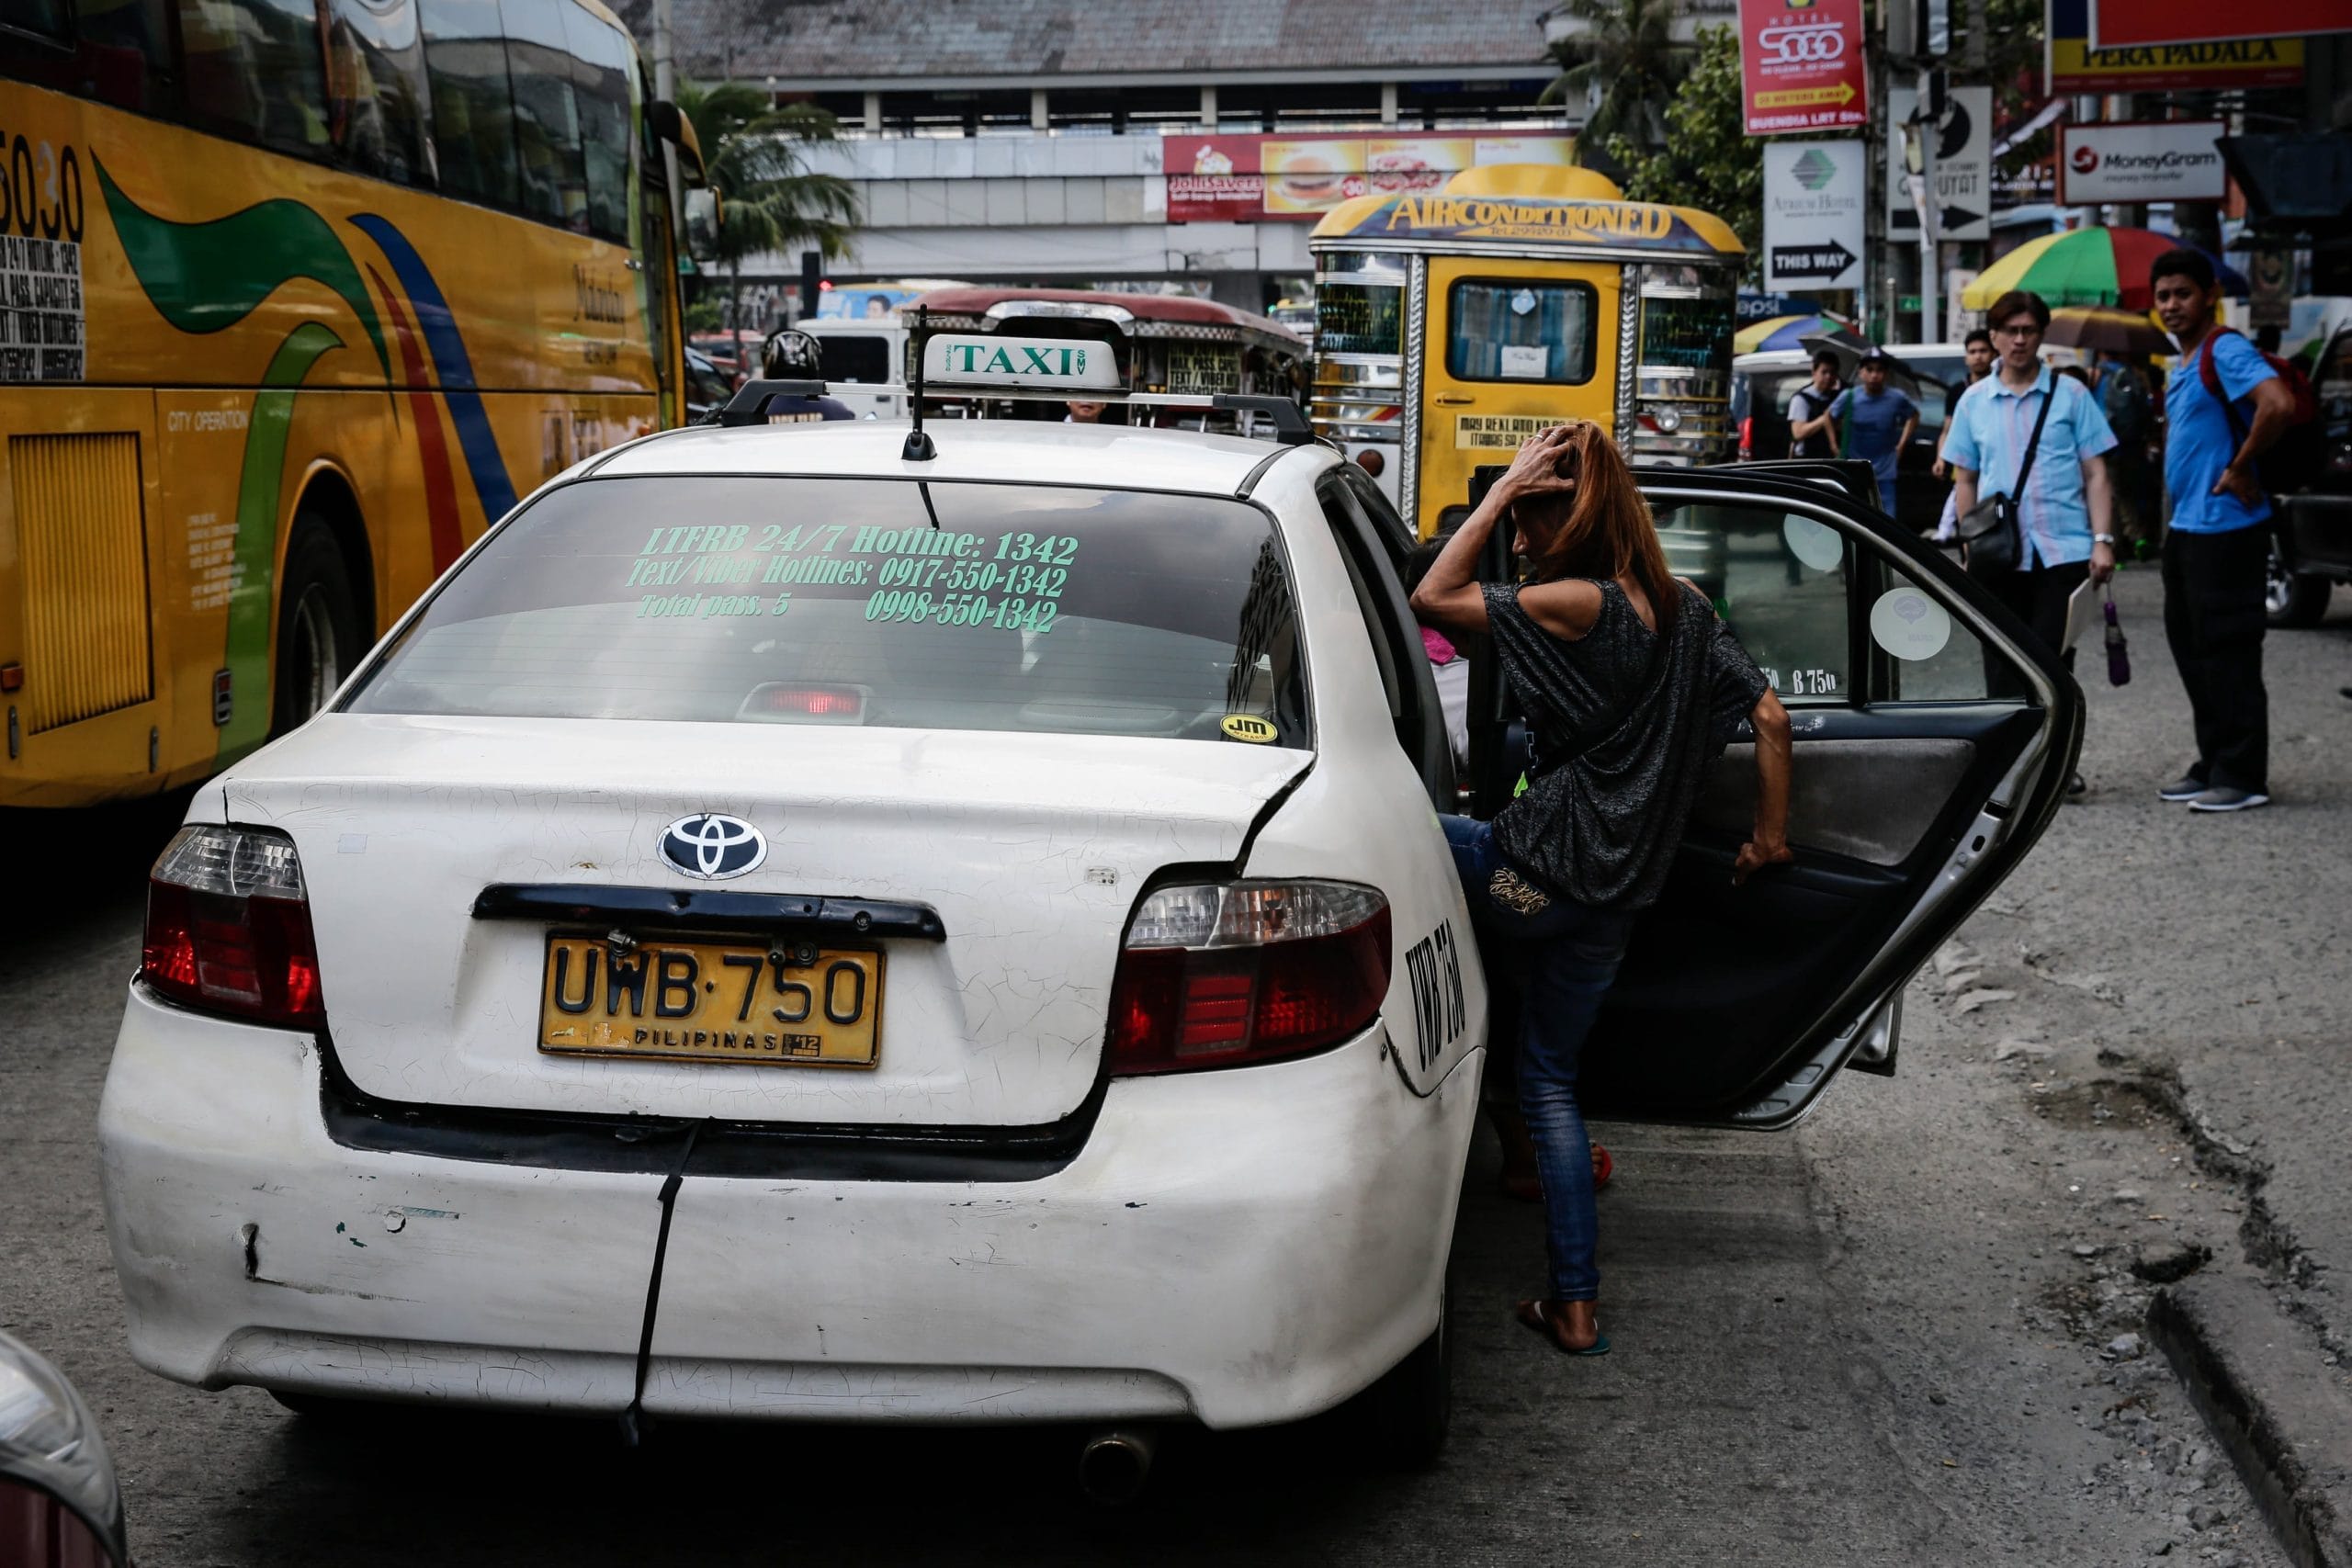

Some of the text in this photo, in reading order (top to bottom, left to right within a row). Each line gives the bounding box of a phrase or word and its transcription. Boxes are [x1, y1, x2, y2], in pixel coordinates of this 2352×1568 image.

[1769, 13, 1831, 28] HOTEL
[1758, 21, 1845, 65] SOGO
[2162, 37, 2278, 64] PADALA
[1810, 111, 1837, 125] LRT
[2103, 150, 2218, 171] MoneyGram
[1386, 197, 1673, 240] AIRCONDITIONED
[1774, 254, 1847, 269] THIS WAY
[954, 344, 1074, 376] TAXI
[167, 411, 248, 432] CITY OPERATION
[639, 525, 1080, 566] LTFRB 24/7 Hotline: 1342
[625, 554, 1069, 598] Text/Viber Hotlines: 0917-550-1342
[637, 591, 794, 620] Total pass. 5
[865, 590, 1058, 634] 0998-550-1342
[1405, 917, 1466, 1073] UWB 750
[635, 1028, 778, 1050] PILIPINAS
